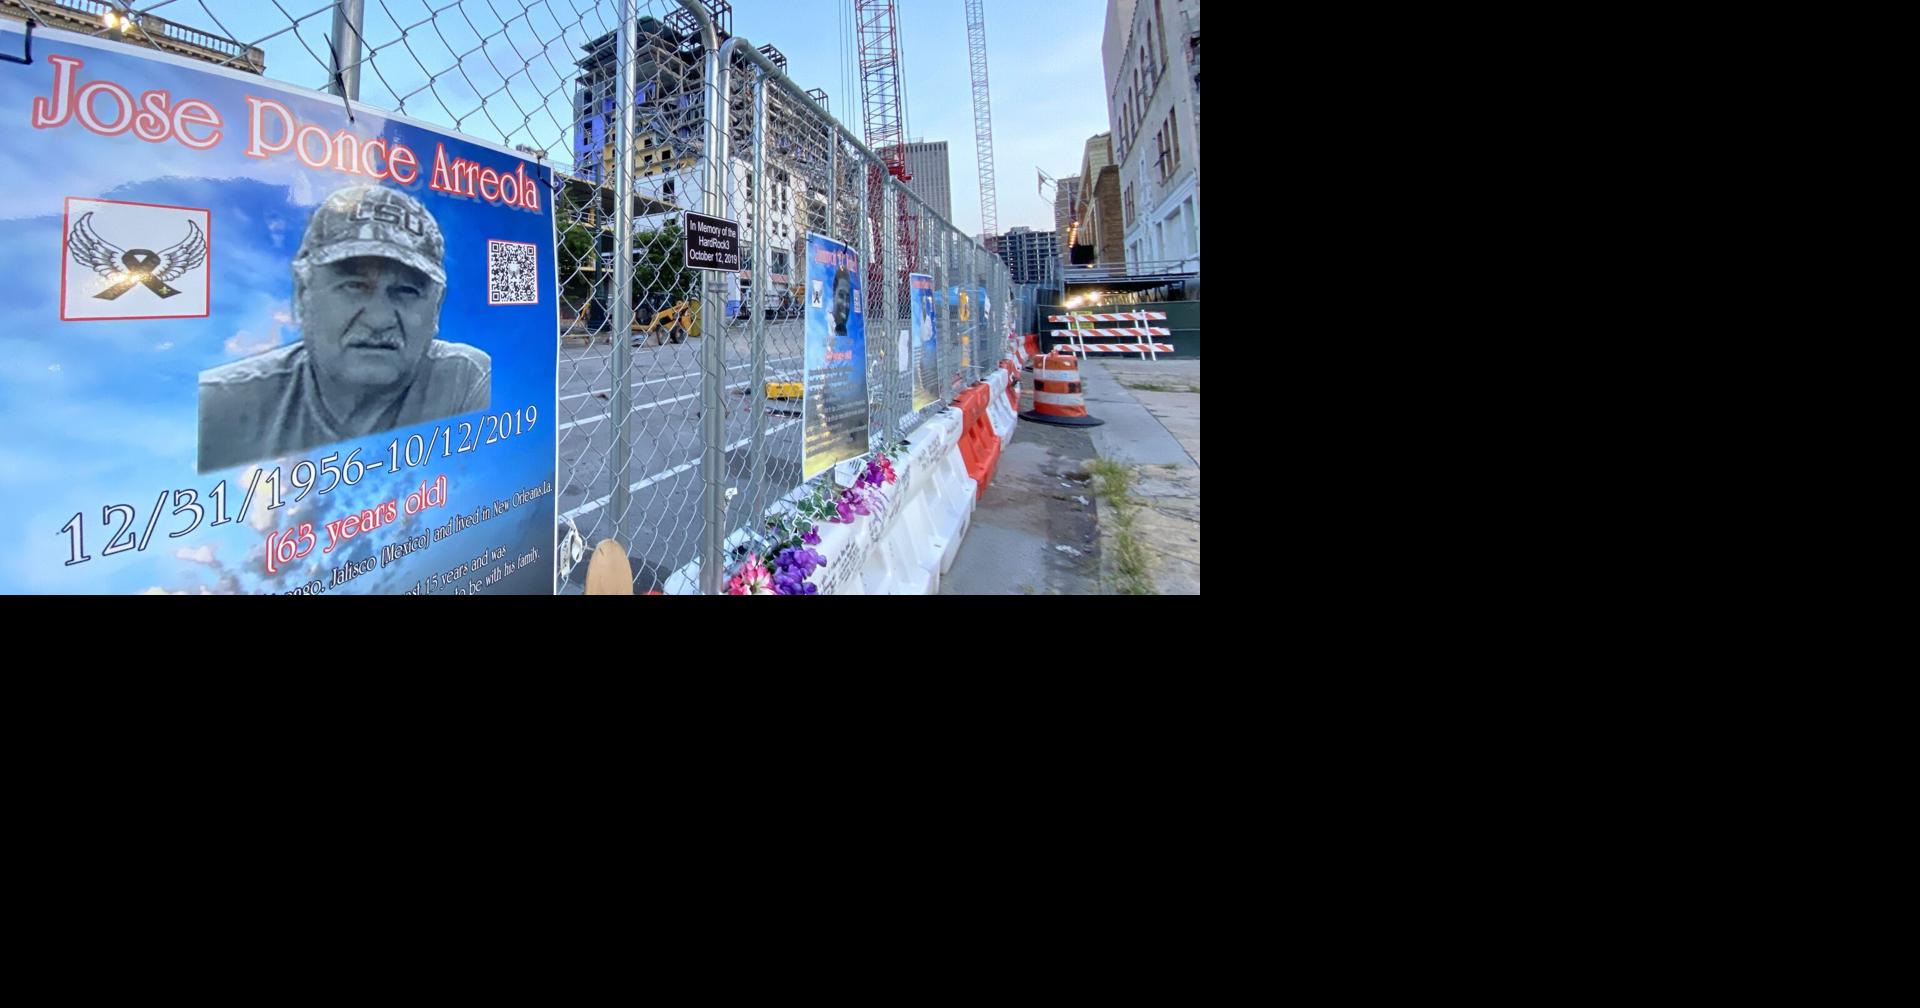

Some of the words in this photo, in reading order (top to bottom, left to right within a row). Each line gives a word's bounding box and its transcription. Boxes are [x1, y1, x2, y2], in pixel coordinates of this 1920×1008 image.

[31, 54, 224, 149] Jose
[244, 94, 418, 185] Ponce
[430, 142, 540, 210] Arreola
[348, 201, 425, 237] LSU
[690, 220, 696, 230] In
[697, 221, 721, 237] Memory
[721, 226, 728, 237] of
[727, 228, 737, 239] the
[698, 235, 730, 250] HardRock3
[689, 248, 714, 261] October
[715, 252, 724, 264] 12,
[724, 253, 738, 265] 2019
[322, 498, 398, 554] years
[329, 560, 377, 590] Jalisco
[433, 516, 453, 542] and
[454, 506, 480, 533] lived
[481, 505, 491, 521] in
[493, 500, 510, 517] New
[424, 573, 438, 594] 15
[440, 563, 469, 590] years
[471, 548, 489, 572] and
[490, 544, 507, 562] was
[468, 577, 484, 595] be
[485, 564, 502, 588] with
[503, 560, 516, 577] his
[517, 547, 541, 575] family.
